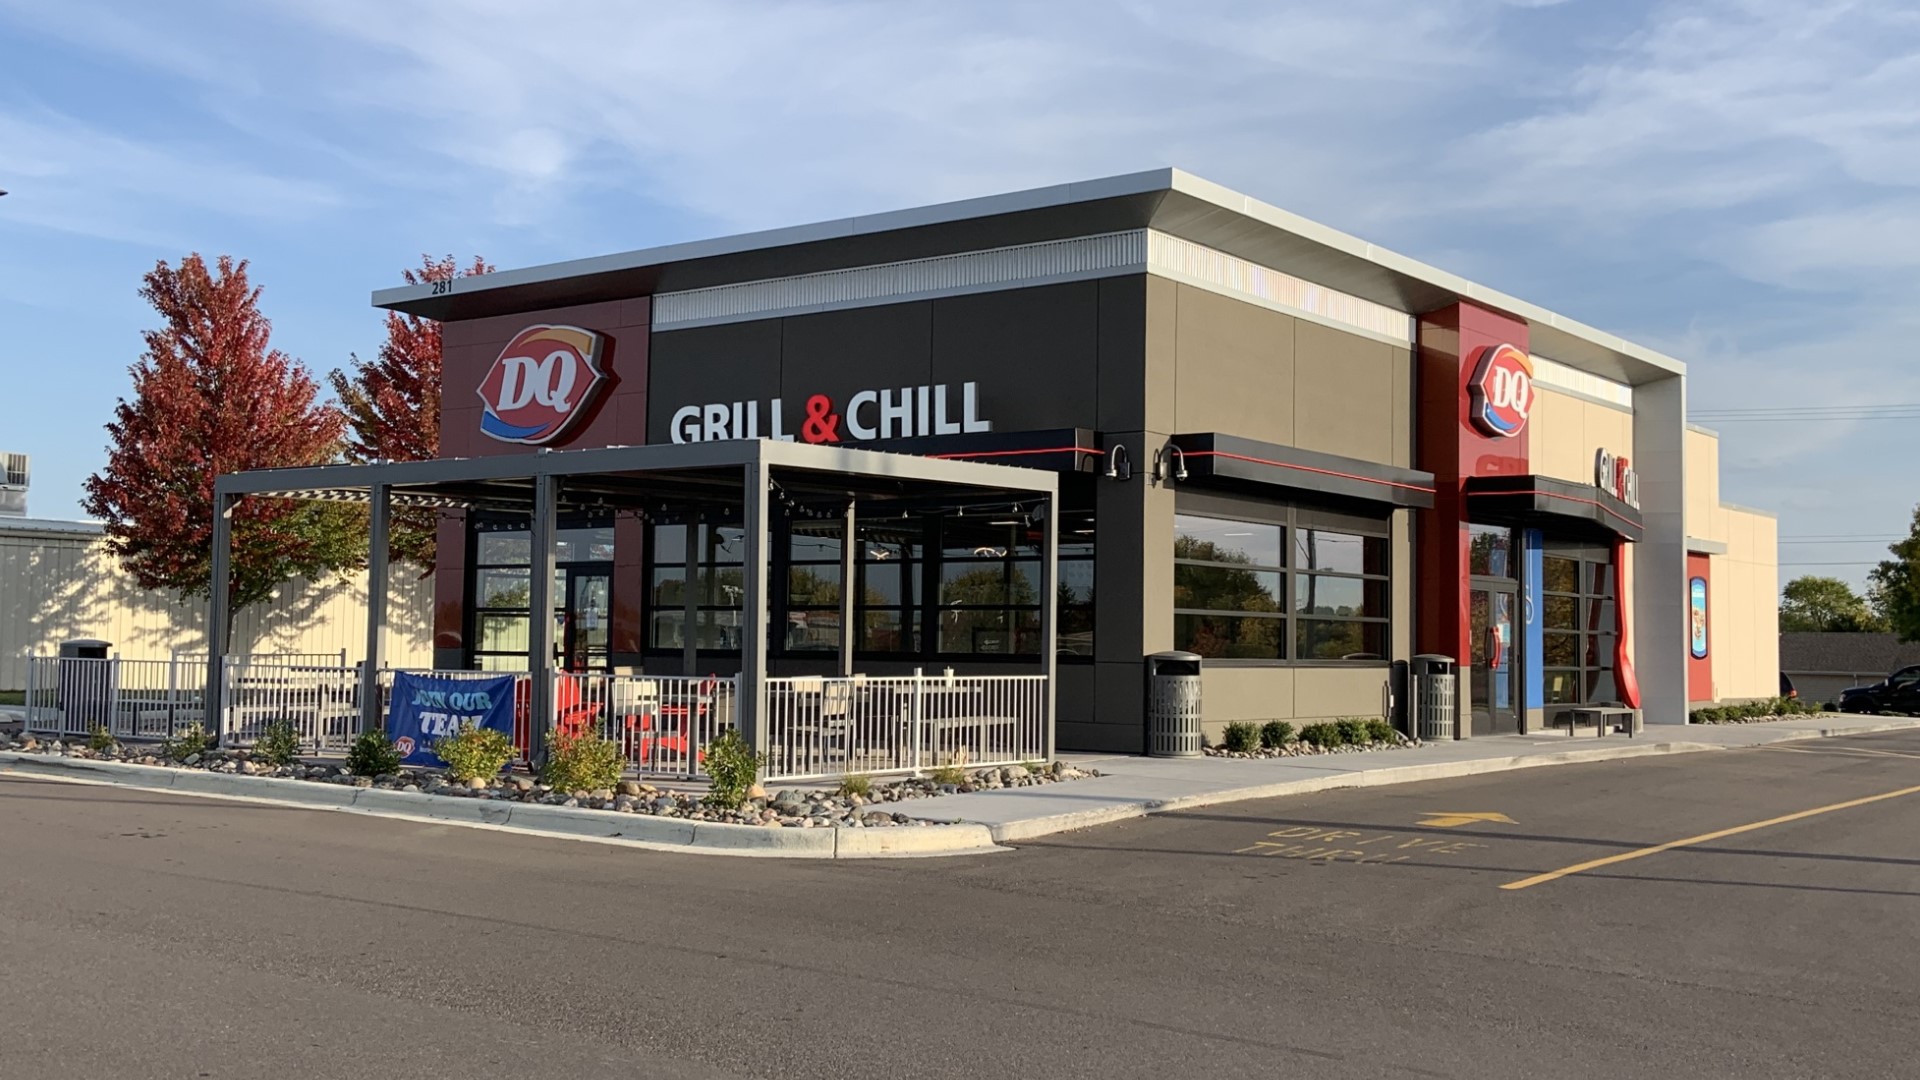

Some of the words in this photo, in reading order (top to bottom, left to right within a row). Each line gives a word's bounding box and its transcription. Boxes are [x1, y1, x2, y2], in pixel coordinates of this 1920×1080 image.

[432, 280, 452, 295] 281
[496, 350, 577, 414] DQ
[1493, 365, 1528, 419] DQ
[670, 398, 795, 444] GRILL
[802, 393, 843, 443] &
[846, 381, 993, 440] CHILL
[412, 689, 448, 709] JOIN
[448, 691, 492, 712] OUR
[396, 741, 411, 754] DQ
[1267, 827, 1489, 854] DRIVE
